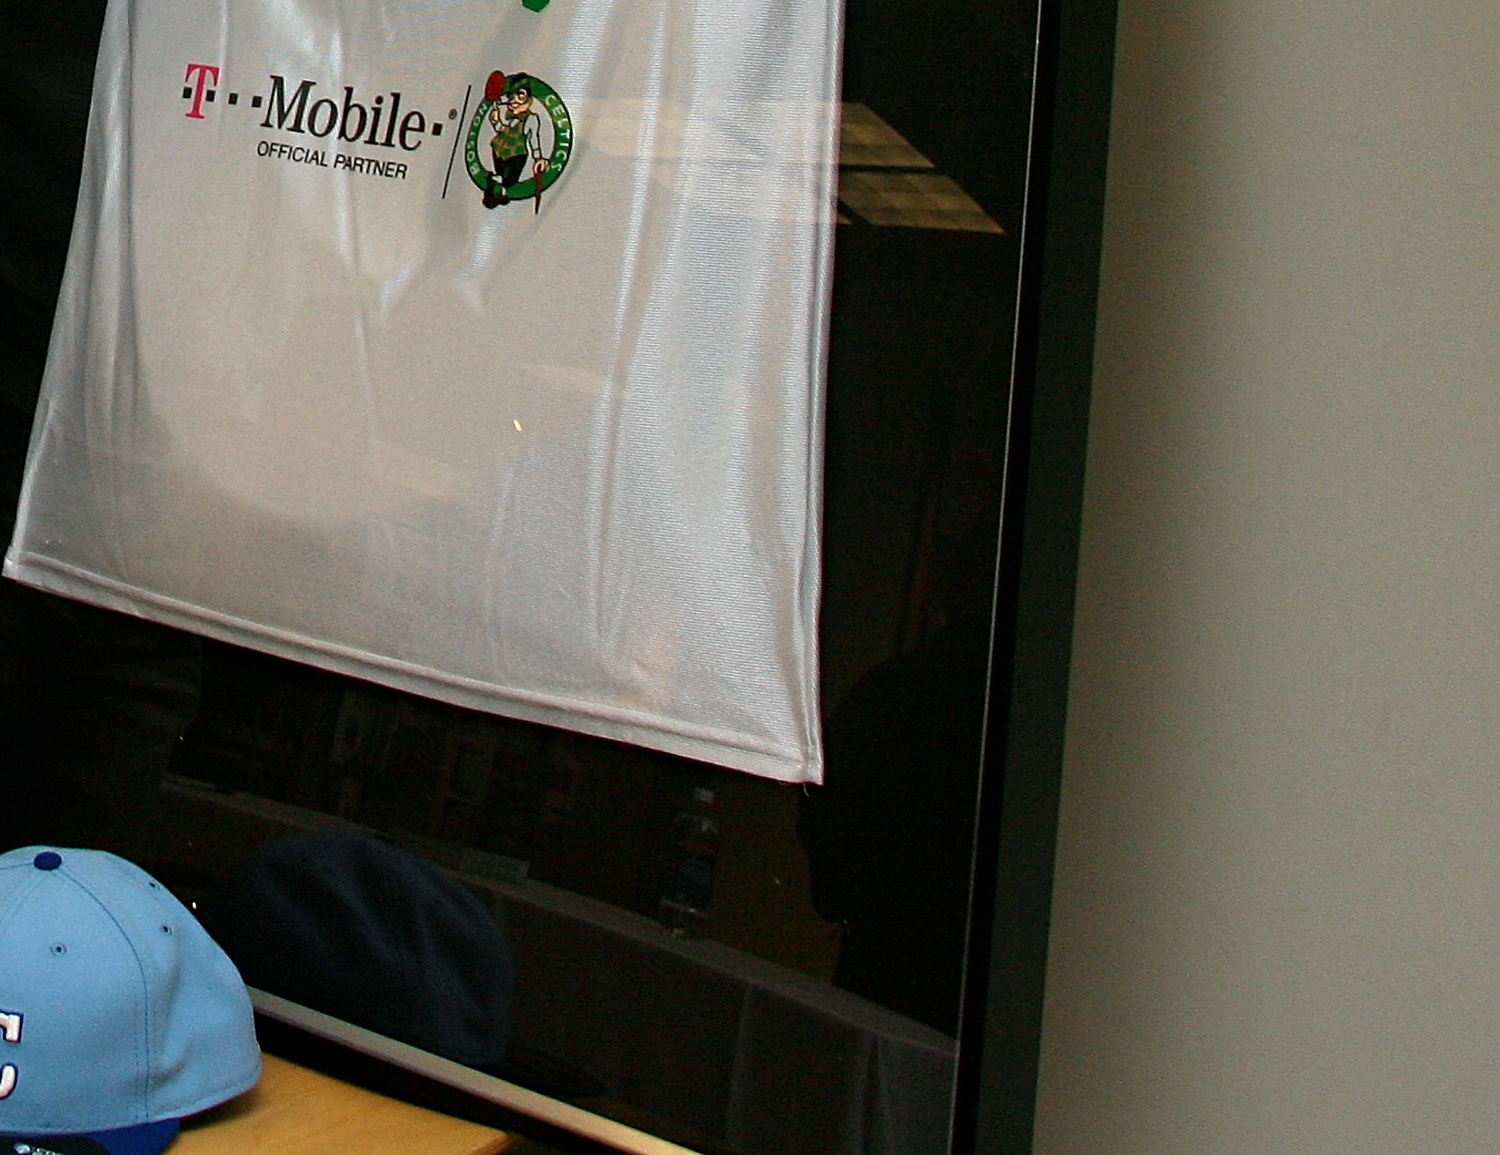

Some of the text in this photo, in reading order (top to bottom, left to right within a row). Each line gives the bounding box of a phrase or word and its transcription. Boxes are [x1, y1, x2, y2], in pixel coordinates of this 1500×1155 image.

[257, 140, 408, 180] OFFICIAL PARTNER
[544, 93, 571, 172] CELTICS
